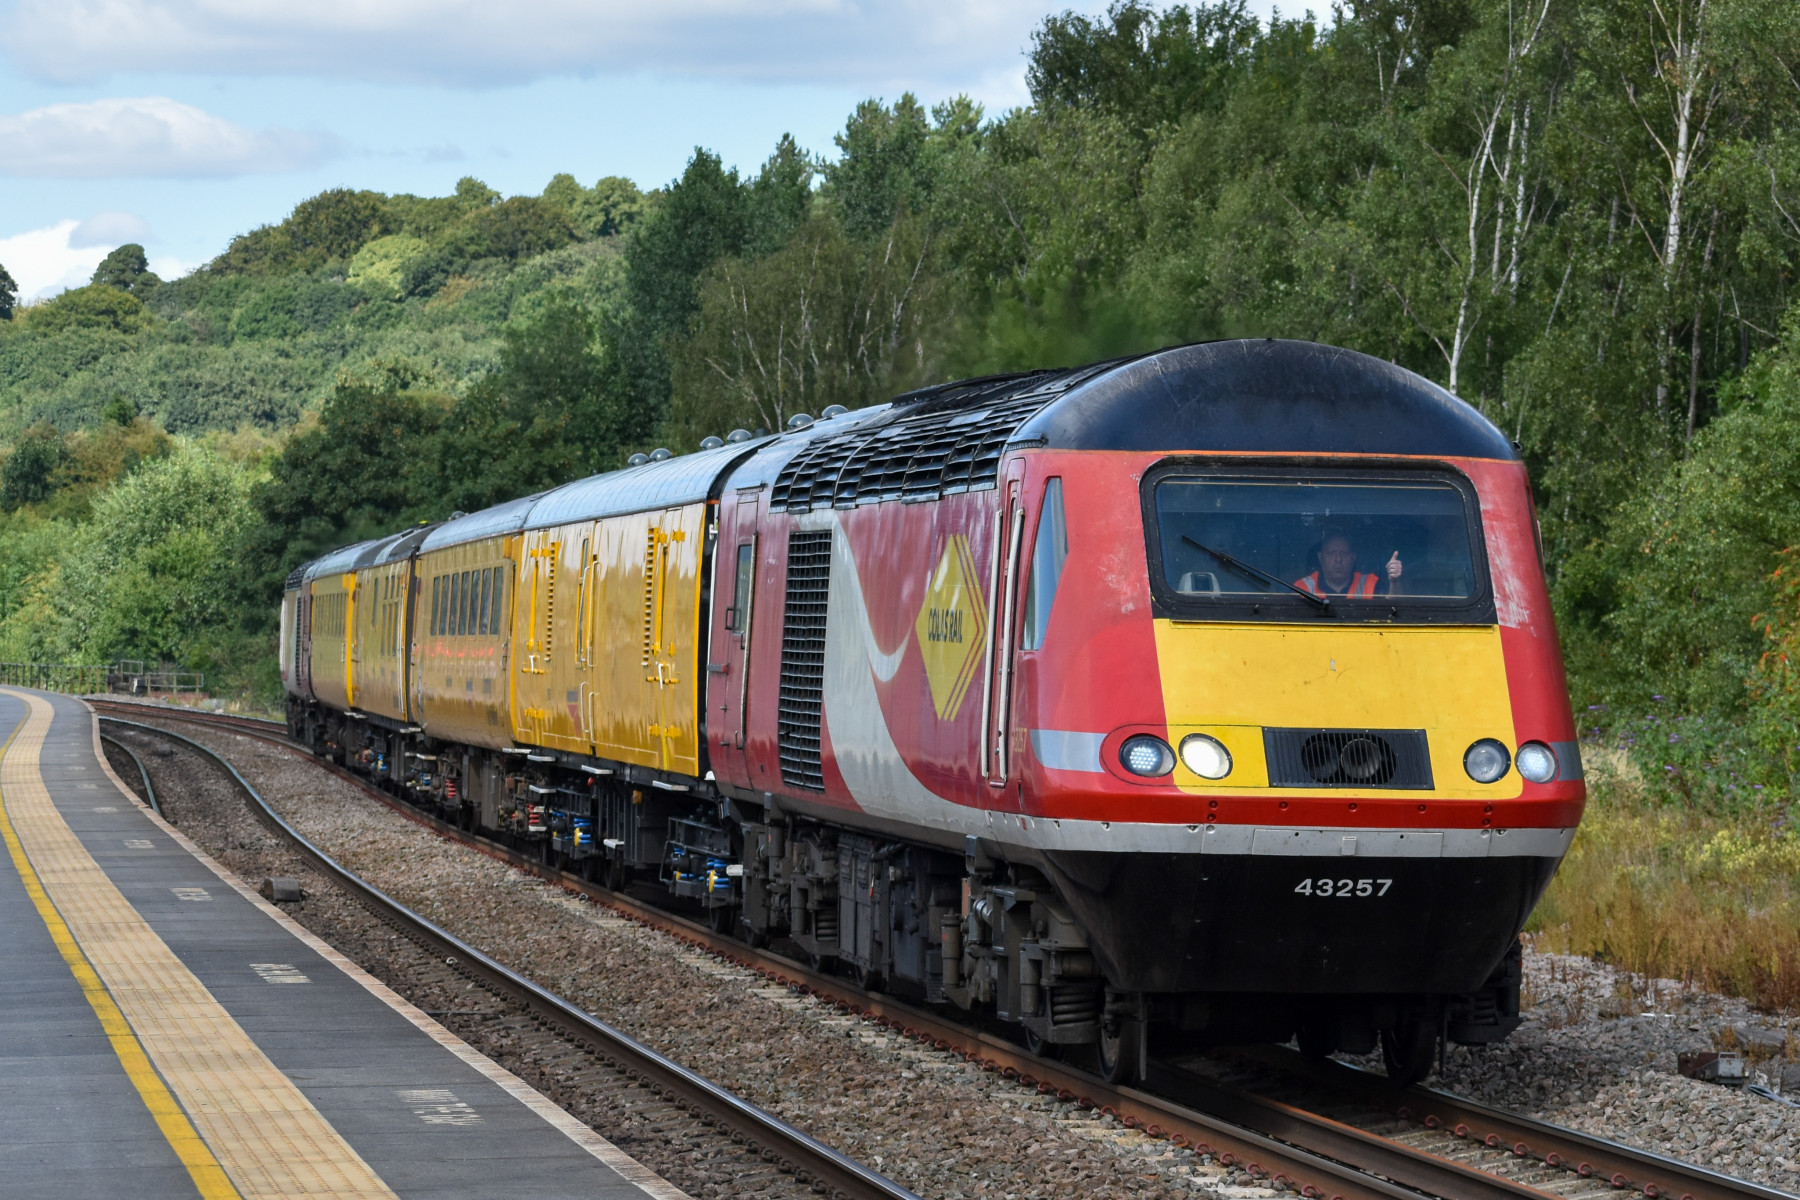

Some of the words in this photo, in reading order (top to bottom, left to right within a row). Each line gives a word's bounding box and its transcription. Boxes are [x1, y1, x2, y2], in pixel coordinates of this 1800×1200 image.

[928, 608, 949, 642] COLAS
[949, 609, 963, 643] RAIL
[1294, 878, 1393, 897] 43257
